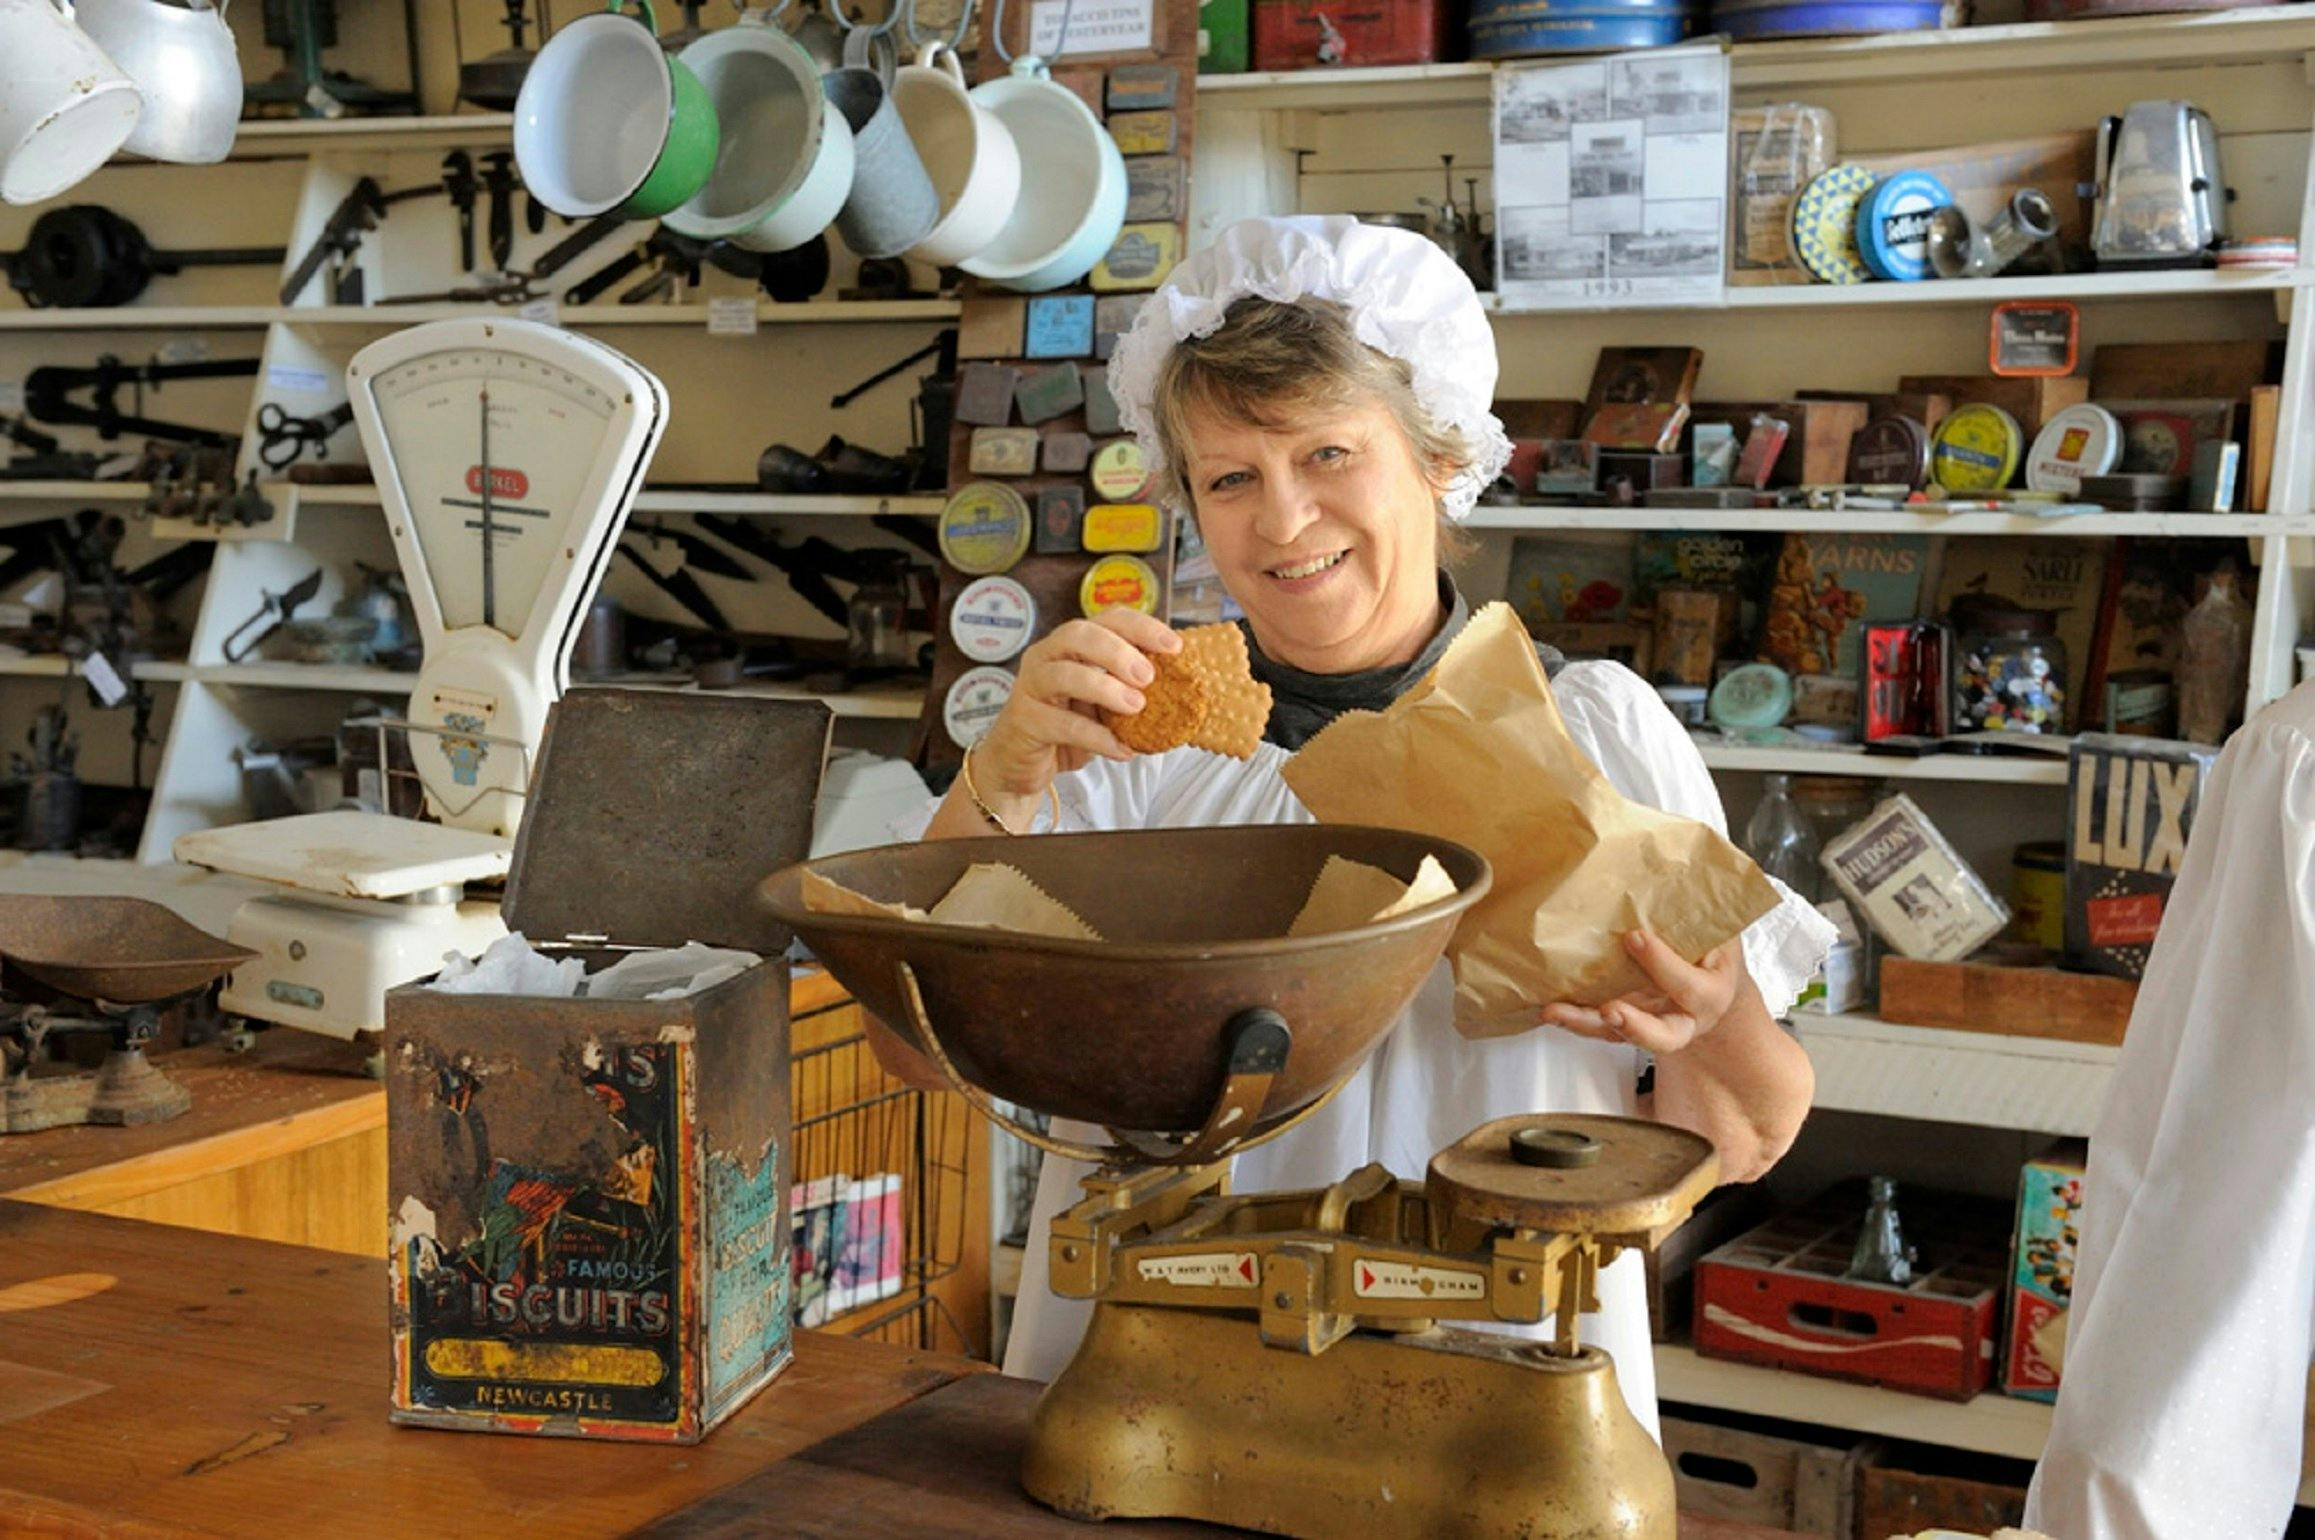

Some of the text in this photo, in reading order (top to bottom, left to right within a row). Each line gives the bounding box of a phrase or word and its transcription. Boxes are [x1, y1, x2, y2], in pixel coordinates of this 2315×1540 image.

[1583, 279, 1634, 297] 1993
[473, 473, 520, 493] BRKEL
[2075, 753, 2197, 875] LUX
[567, 1257, 658, 1284] FAMOUS
[1383, 1275, 1479, 1291] BIRMGHAM
[475, 1384, 613, 1412] NEWCASTLE
